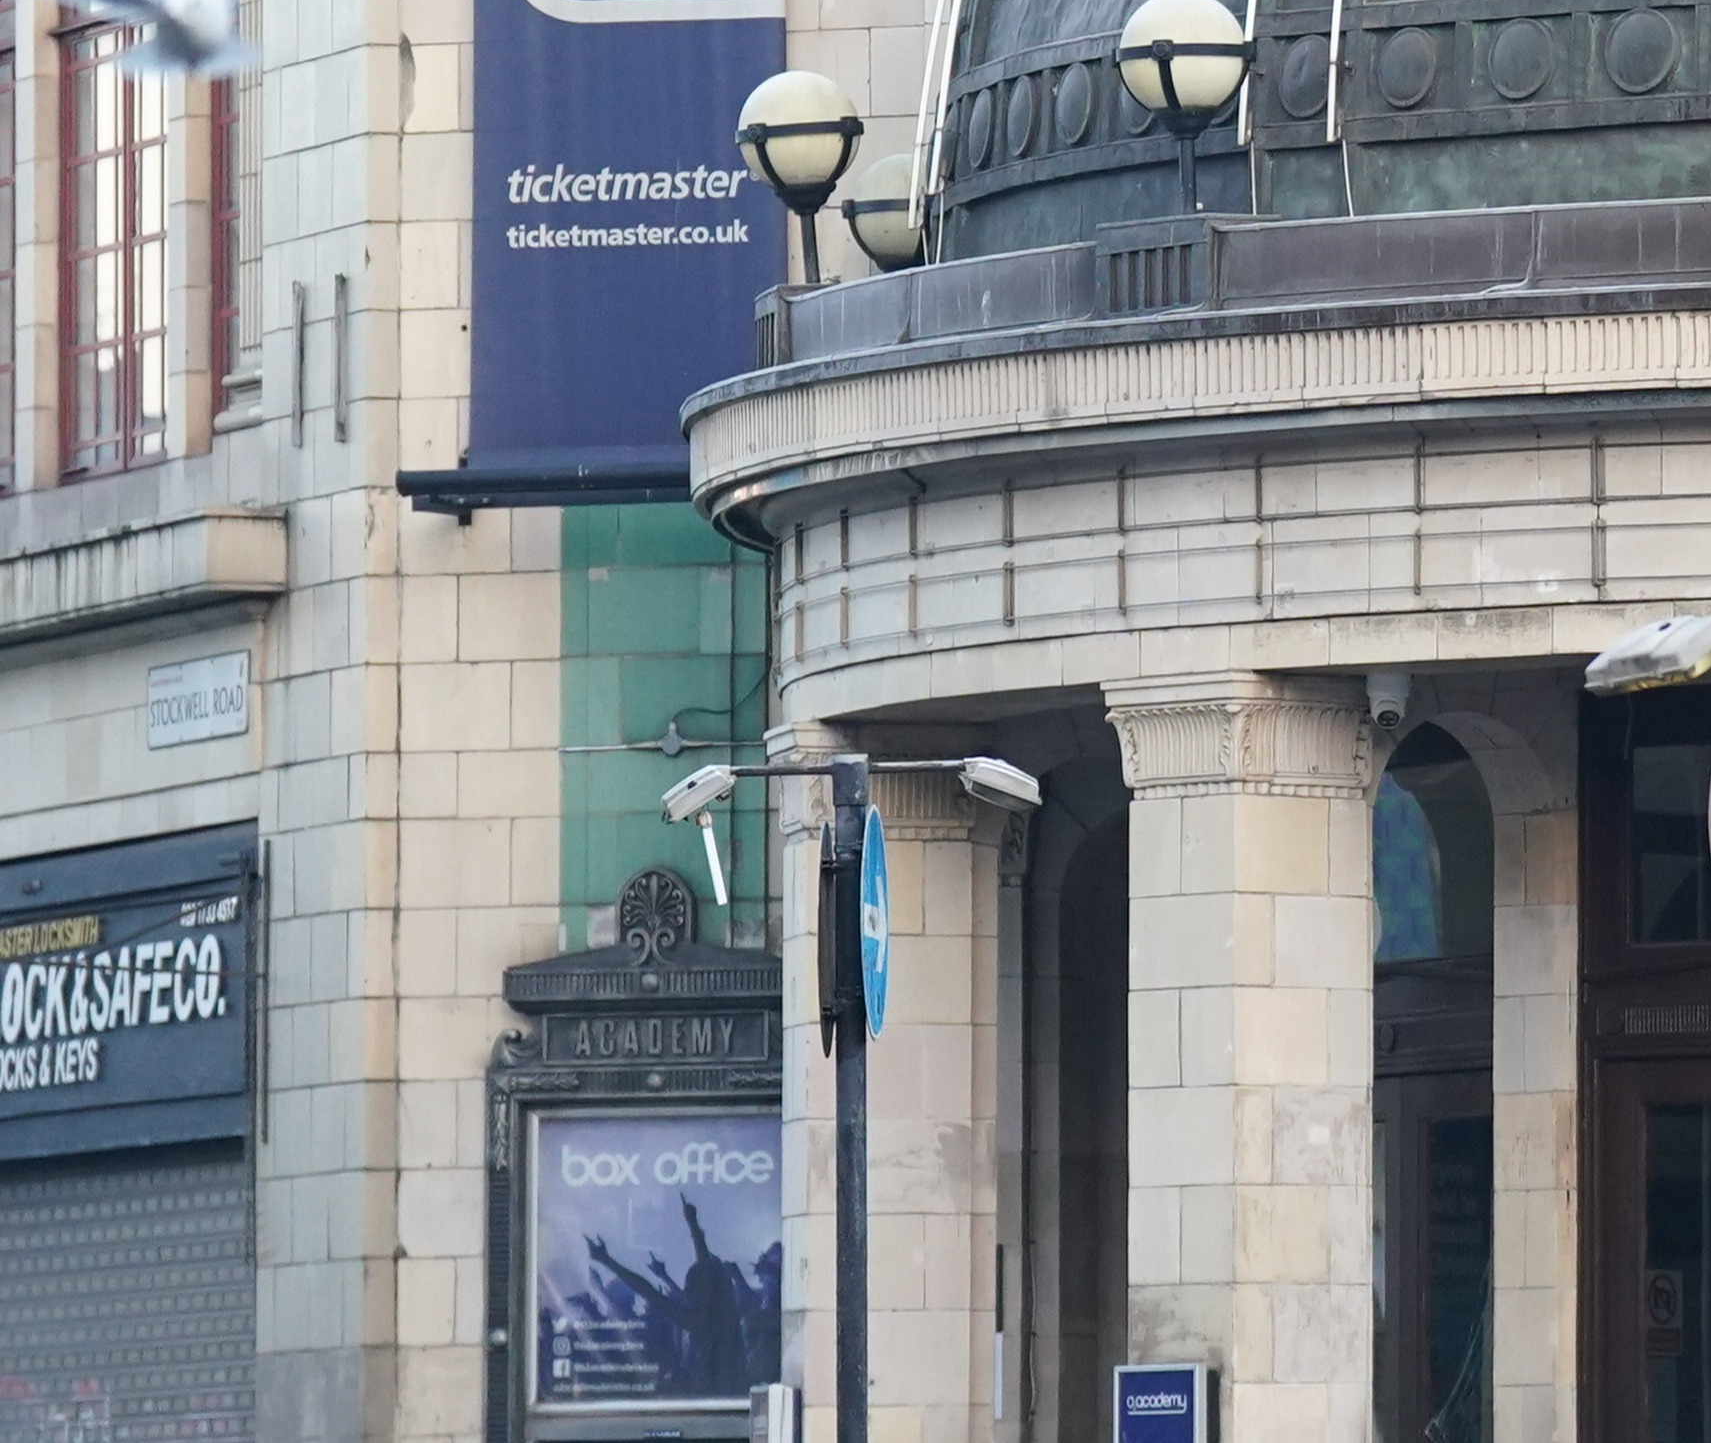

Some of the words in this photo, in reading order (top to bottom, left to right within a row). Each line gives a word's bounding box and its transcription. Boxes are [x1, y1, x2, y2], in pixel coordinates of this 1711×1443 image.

[507, 163, 748, 204] ticketmaster
[506, 218, 750, 249] ticketmaster.co.uk
[150, 690, 209, 728] STOCKWELL
[213, 684, 244, 716] ROAD
[33, 915, 99, 954] LOCKSMITH
[575, 1017, 735, 1057] ACADEMY
[54, 1037, 99, 1085] KEYS
[561, 1144, 641, 1188] box
[652, 1141, 775, 1186] office
